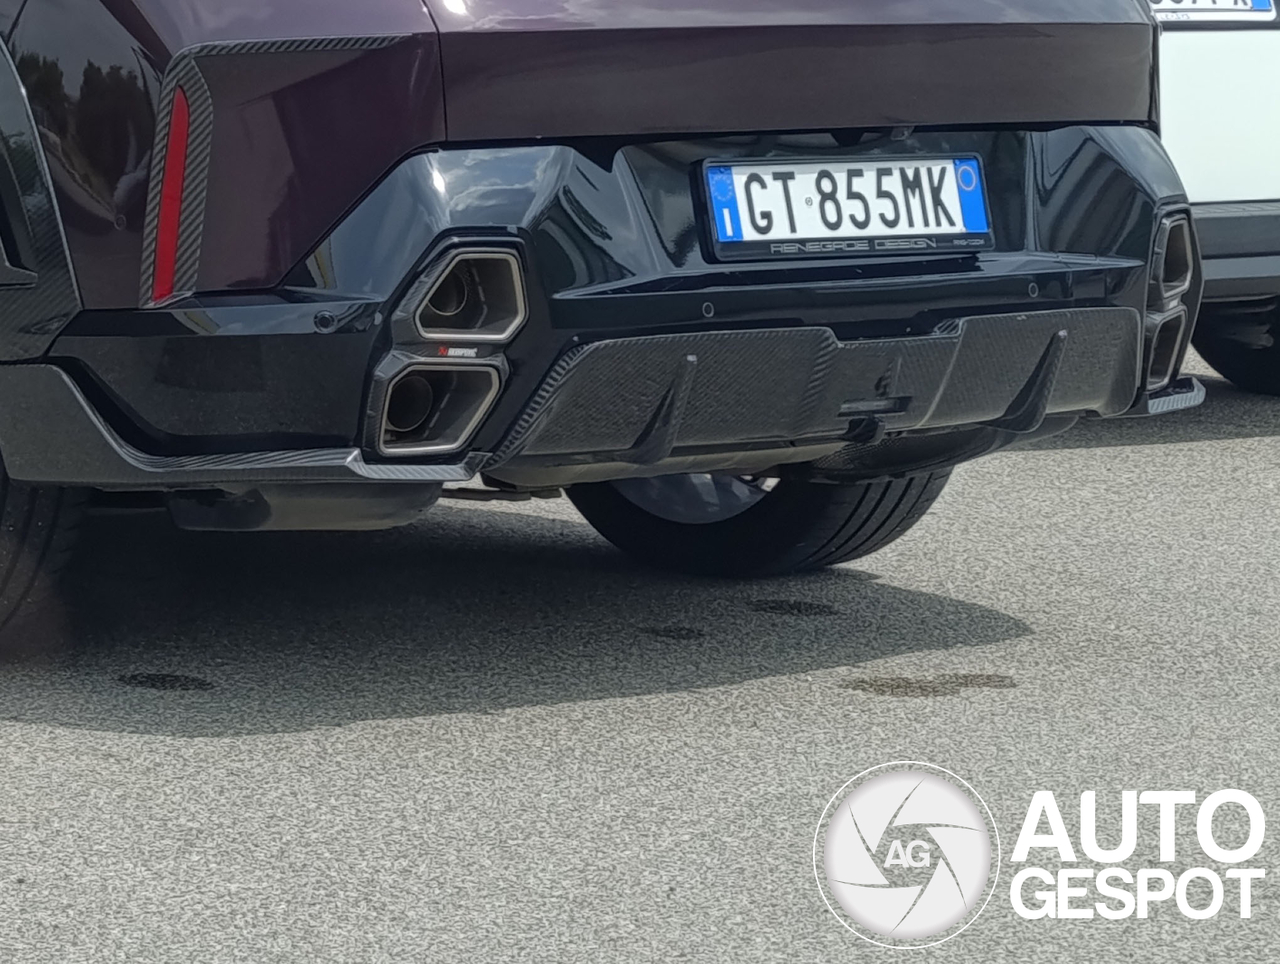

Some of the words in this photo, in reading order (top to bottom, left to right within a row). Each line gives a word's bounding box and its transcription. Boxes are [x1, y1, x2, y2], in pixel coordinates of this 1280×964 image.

[722, 208, 734, 237] I
[744, 170, 797, 235] GT
[815, 166, 957, 231] 855MK
[770, 239, 870, 254] RENEGADE
[874, 237, 937, 250] DESIGN
